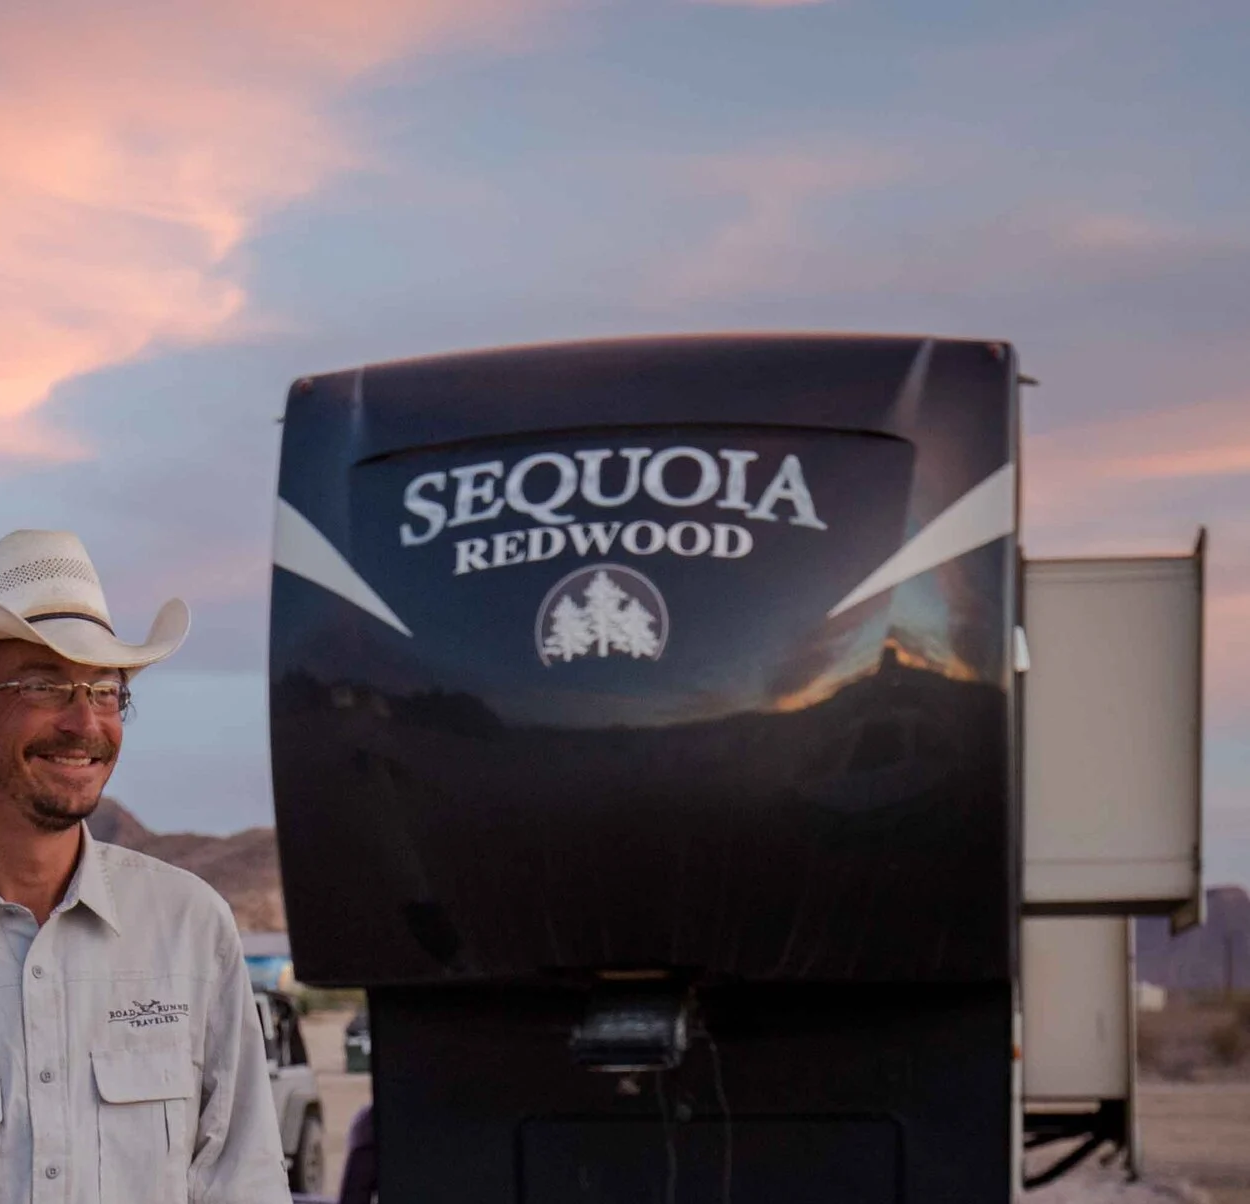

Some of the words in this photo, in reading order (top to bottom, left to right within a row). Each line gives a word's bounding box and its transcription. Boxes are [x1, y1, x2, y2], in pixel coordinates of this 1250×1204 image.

[400, 446, 827, 546] SEQUOIA
[453, 520, 754, 575] REDWOOD
[109, 1010, 136, 1019] ROAD
[129, 1015, 179, 1027] TRAVELERS
